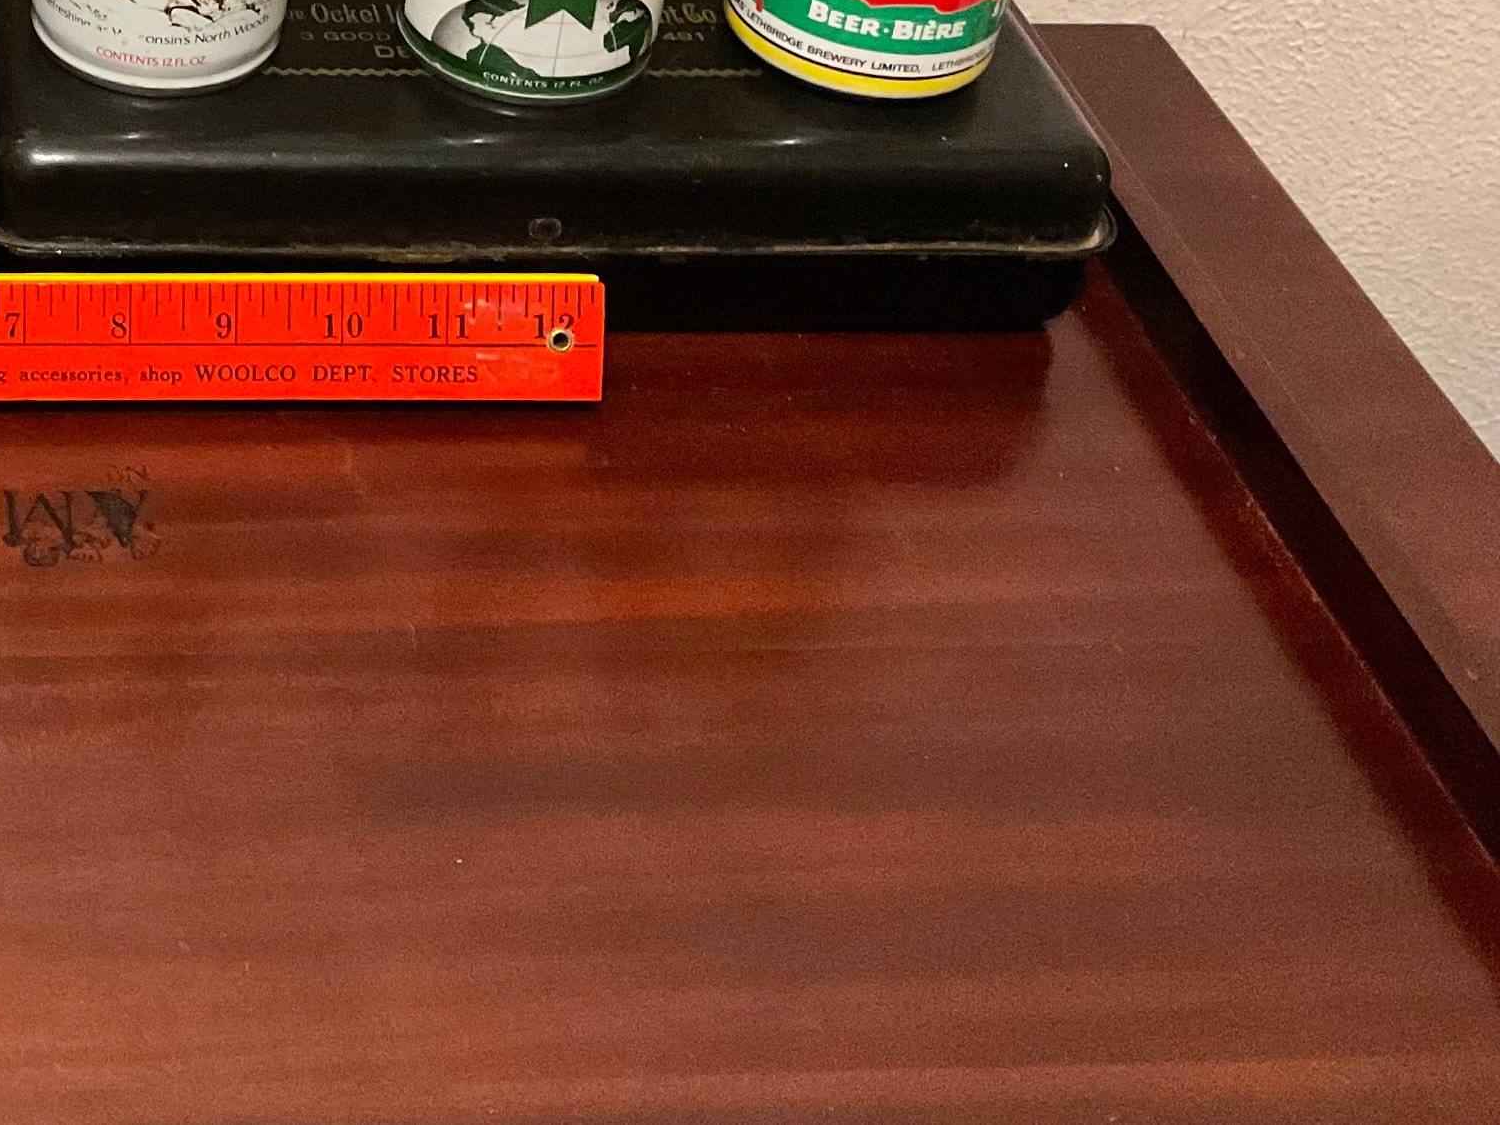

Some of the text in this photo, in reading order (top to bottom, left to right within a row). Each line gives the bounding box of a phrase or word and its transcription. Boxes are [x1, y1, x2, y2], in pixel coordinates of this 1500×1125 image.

[194, 29, 231, 45] North
[746, 8, 804, 51] LETHBRIDGE
[806, 43, 868, 70] BREWERY
[870, 59, 921, 75] LIMITED,
[96, 46, 159, 67] CONTENTS
[482, 71, 548, 89] CONTENTS
[4, 313, 20, 337] 7
[110, 312, 127, 338] 8
[215, 312, 232, 338] 9
[19, 364, 129, 386] accessories,
[140, 364, 183, 386] shop
[195, 364, 296, 383] WOOLCO
[312, 365, 376, 382] DEPT.
[392, 365, 478, 383] STORES
